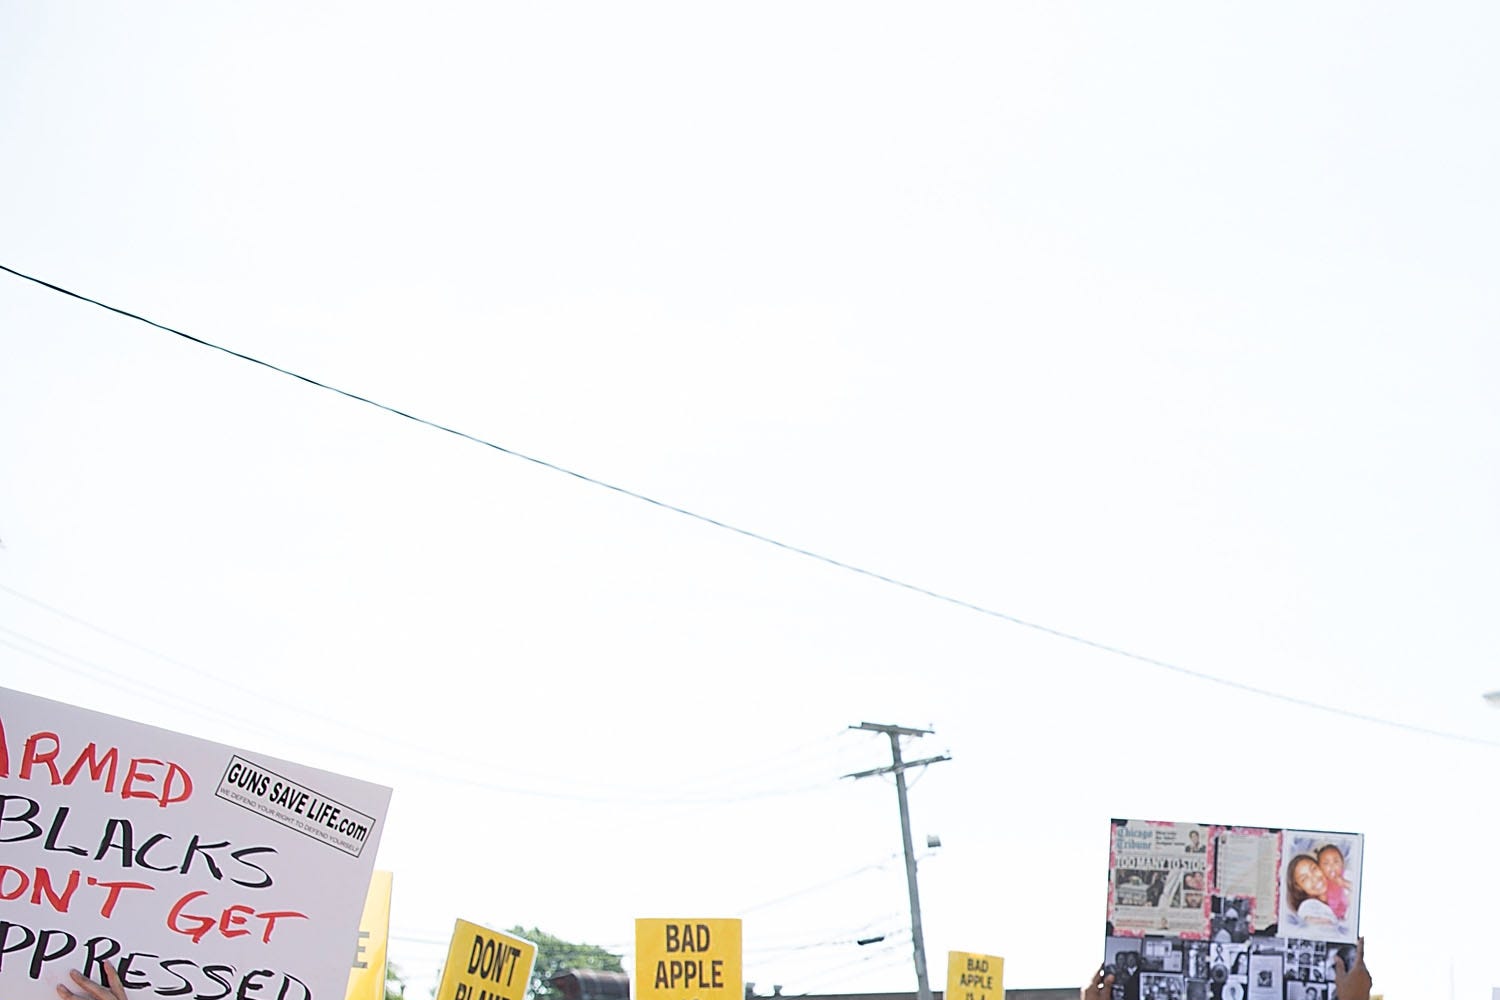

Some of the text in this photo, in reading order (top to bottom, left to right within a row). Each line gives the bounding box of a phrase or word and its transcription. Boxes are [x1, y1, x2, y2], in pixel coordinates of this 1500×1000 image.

[220, 787, 360, 852] WE DEFEND YOUR RIGHT TO DEFEND YOURSELF
[227, 763, 368, 842] GUNS SAVE LIFE.com
[0, 794, 279, 889] BLACKS
[0, 865, 310, 945] ON'T GET
[467, 934, 522, 987] DON'T
[665, 924, 711, 953] BAD
[655, 959, 724, 991] APPLE
[960, 973, 993, 990] APPLE
[967, 958, 989, 973] BAD
